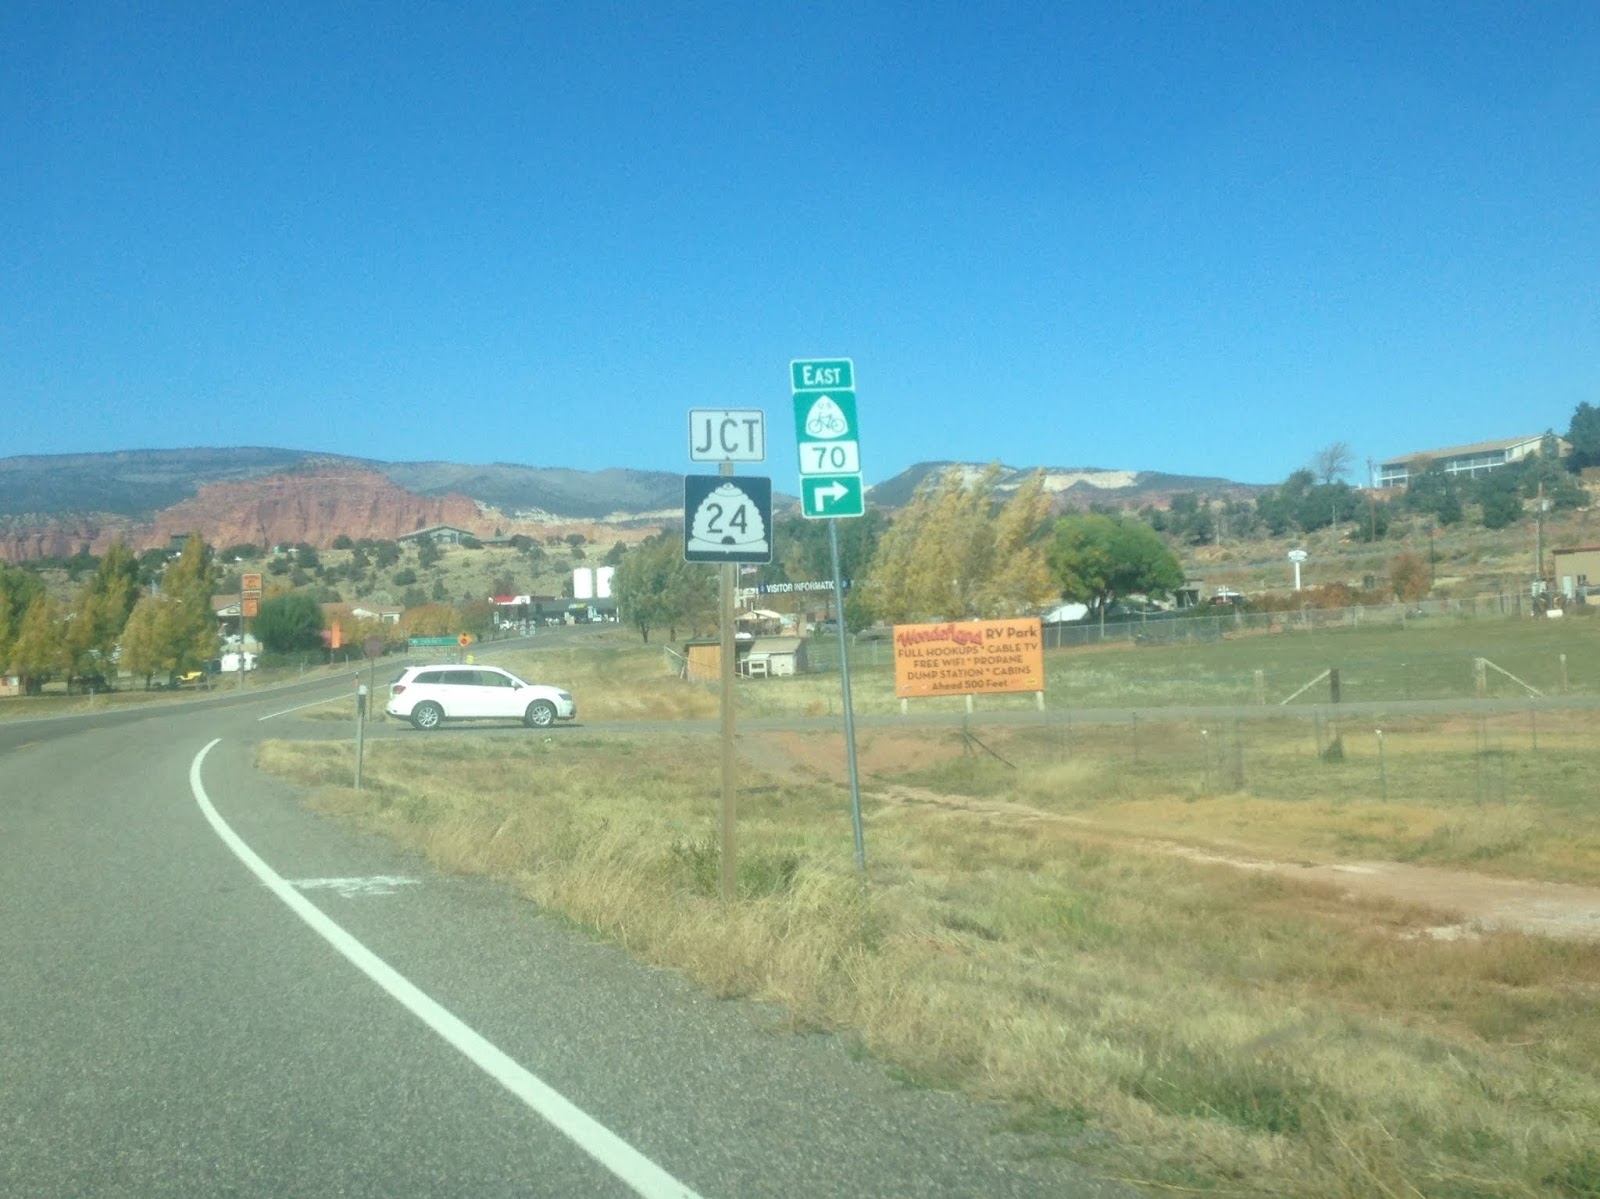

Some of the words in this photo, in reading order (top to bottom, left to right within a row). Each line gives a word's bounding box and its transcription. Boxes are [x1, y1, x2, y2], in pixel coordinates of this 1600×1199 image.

[802, 365, 841, 385] EAST
[695, 419, 759, 454] JCT
[812, 446, 846, 469] 70
[706, 503, 748, 534] 24
[766, 583, 793, 593] VISITOR
[986, 628, 1004, 639] RV
[1007, 626, 1037, 638] Park
[898, 649, 925, 658] FULL
[926, 646, 979, 657] HOOKUPS
[988, 643, 1021, 654] CABLE
[1024, 642, 1038, 651] TV
[913, 659, 940, 668] FREE
[942, 657, 965, 666] WIFI
[974, 655, 1024, 665] PROPANE
[907, 670, 938, 680] DUMP
[940, 668, 984, 678] STATION
[992, 666, 1032, 676] CABINS
[932, 680, 963, 690] Ahead
[965, 679, 984, 689] 500
[986, 678, 1008, 688] Feet
